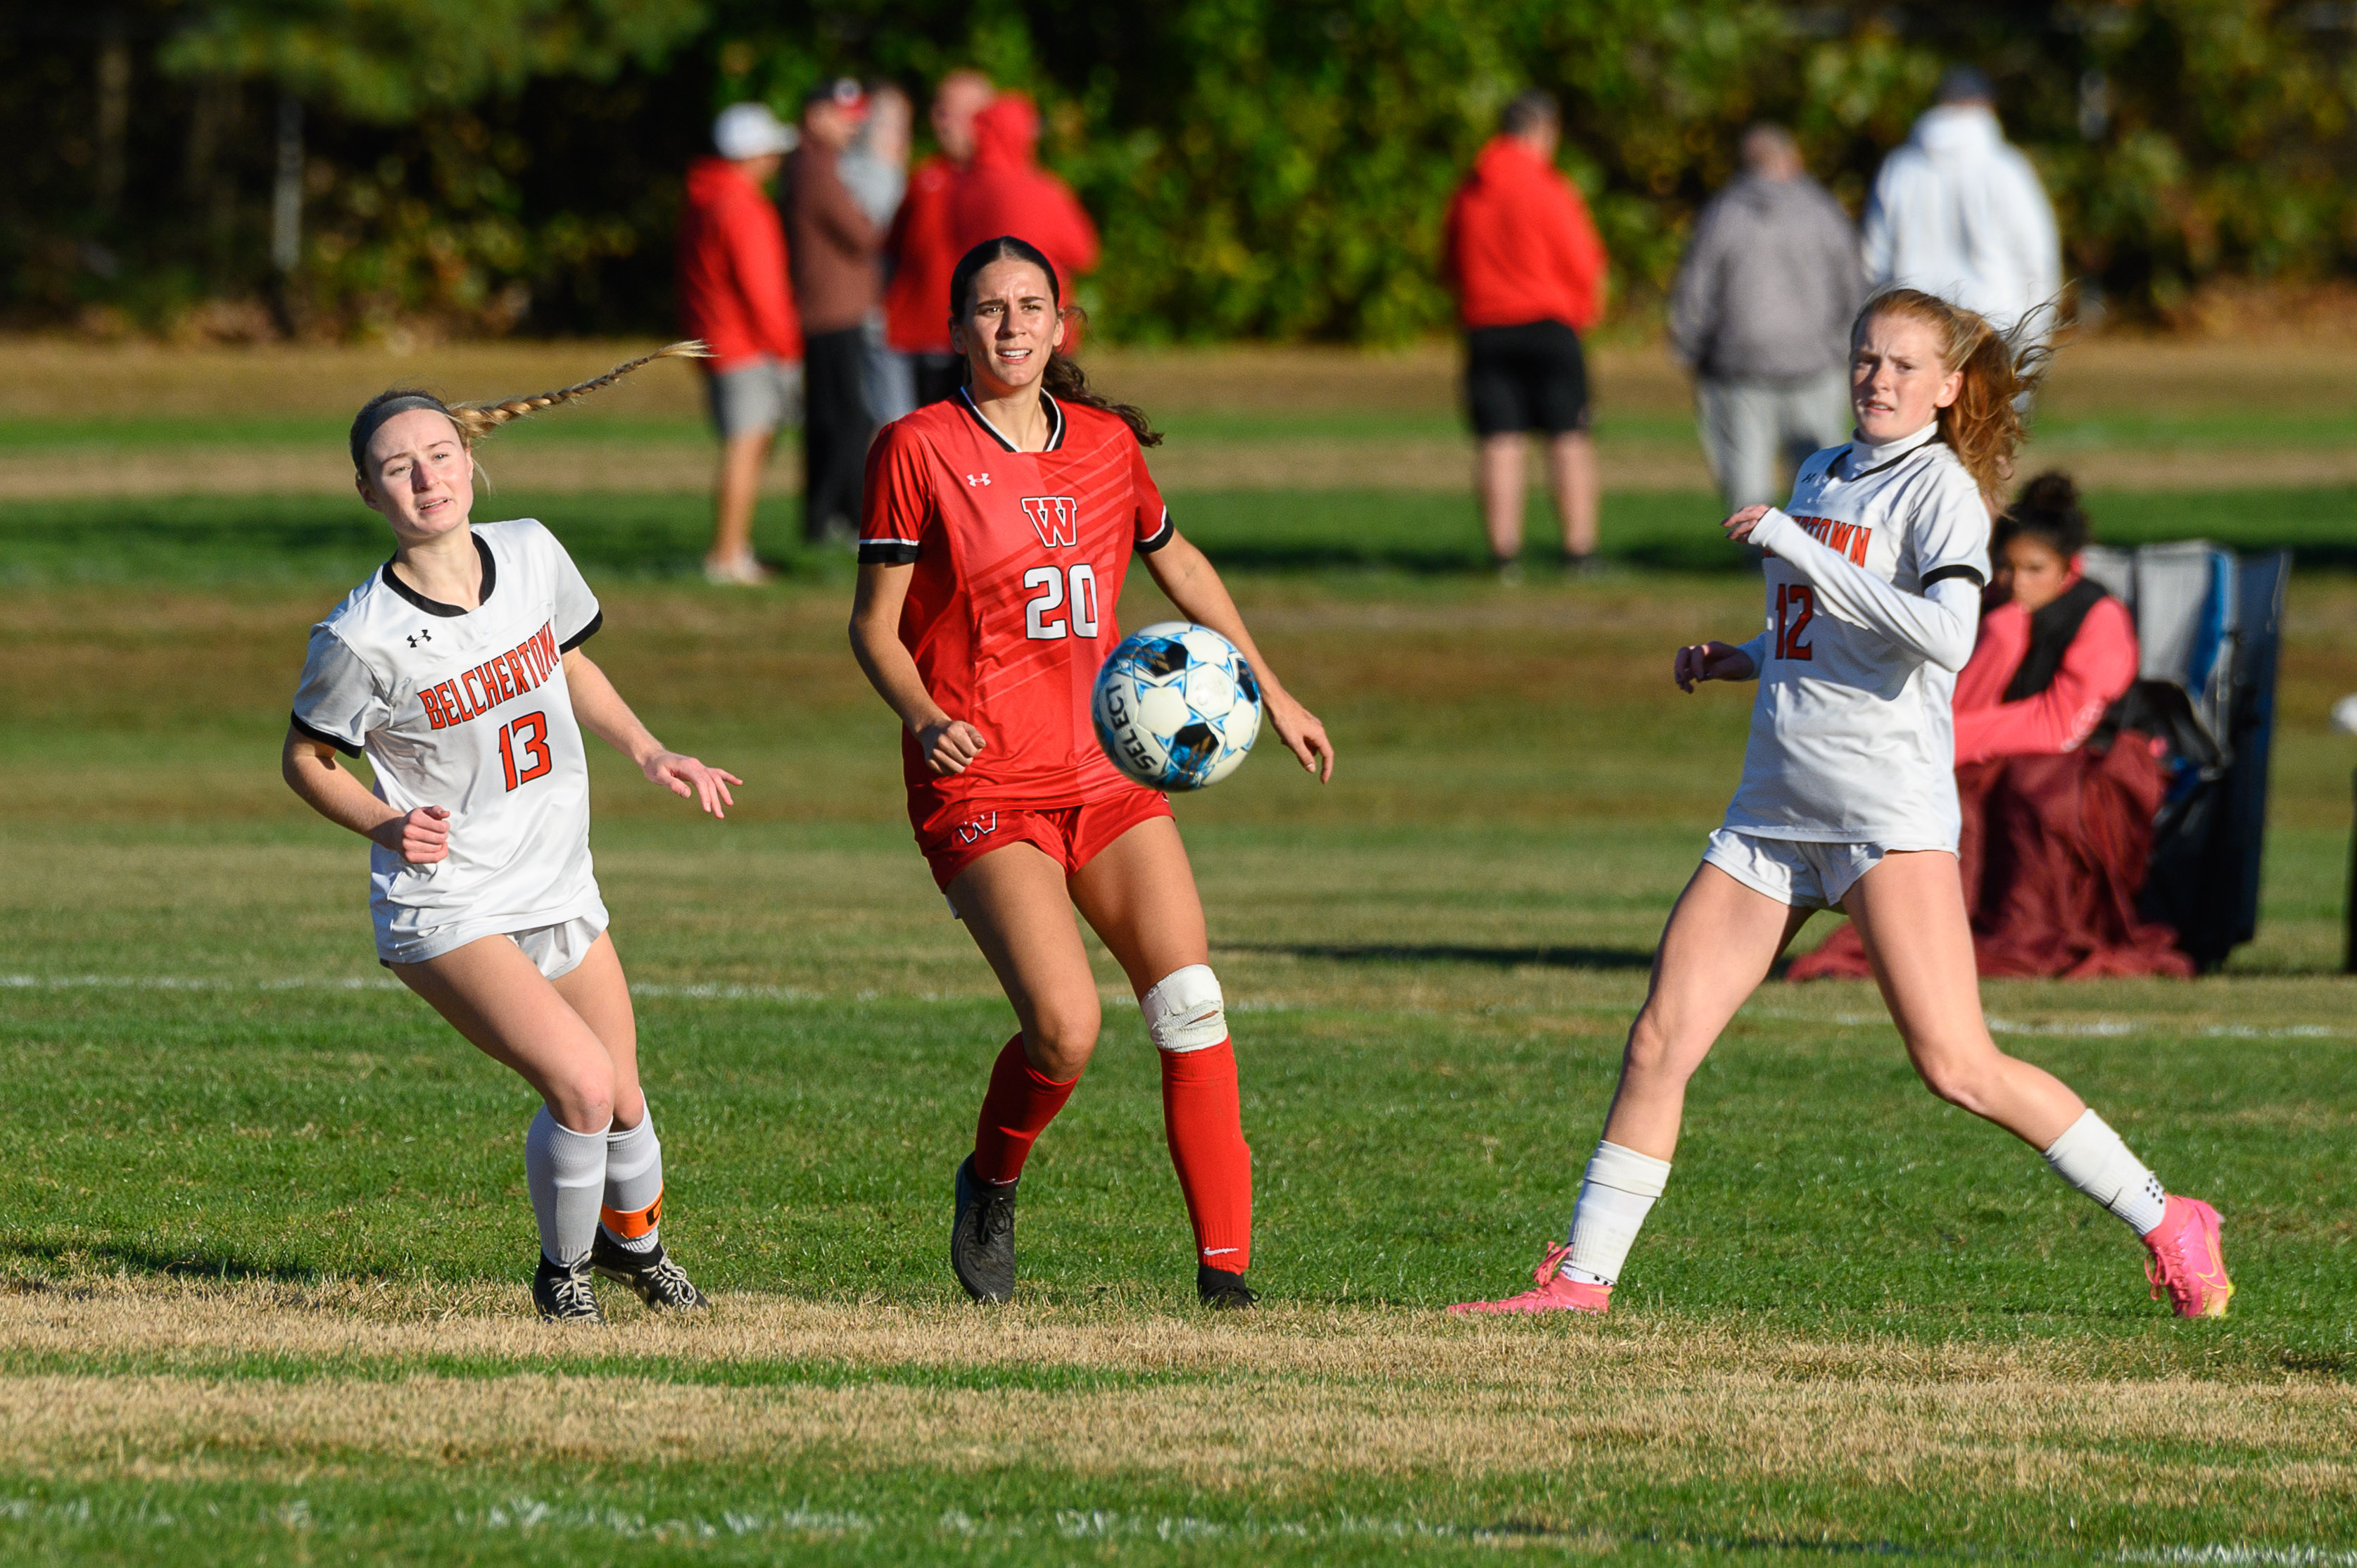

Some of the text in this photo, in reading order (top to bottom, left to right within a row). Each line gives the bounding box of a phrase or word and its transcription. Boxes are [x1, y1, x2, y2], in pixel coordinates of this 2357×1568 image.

[1021, 497, 1078, 548] W
[1023, 564, 1098, 640] 20
[1775, 583, 1813, 661] 12
[498, 710, 552, 793] 13
[1106, 683, 1158, 770] SELECT
